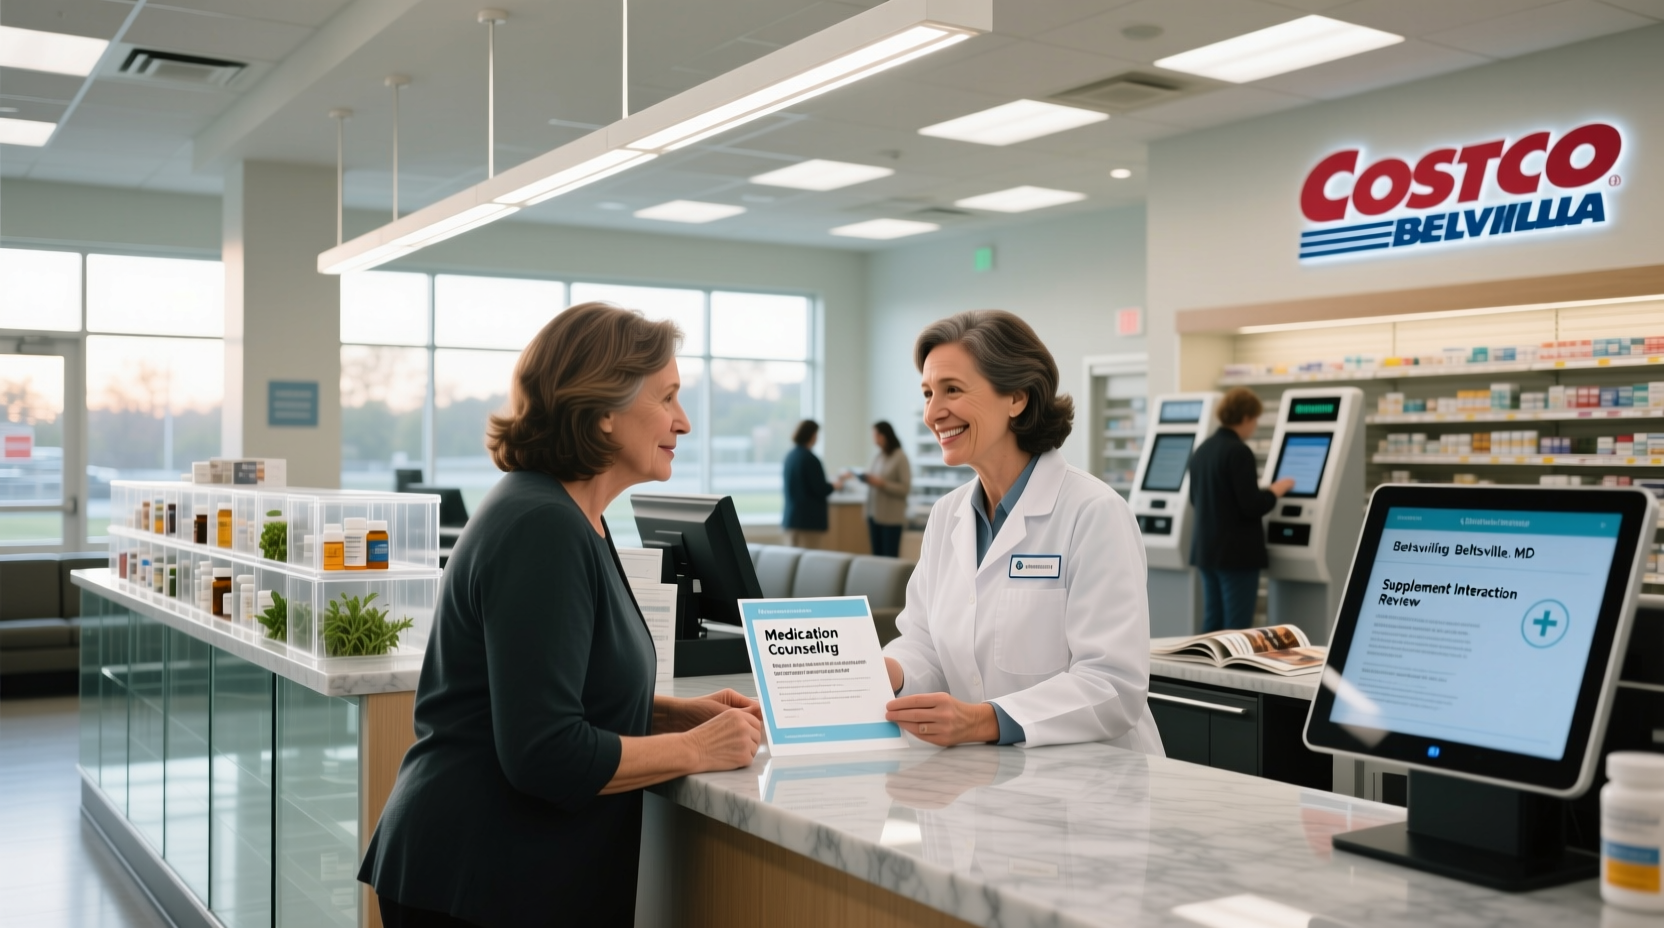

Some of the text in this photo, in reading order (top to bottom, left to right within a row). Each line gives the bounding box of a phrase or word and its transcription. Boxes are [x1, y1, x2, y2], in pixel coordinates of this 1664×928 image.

[1300, 123, 1623, 223] COSTCO
[1514, 546, 1535, 560] MD
[1382, 578, 1518, 600] Supplement Interaction
[1378, 593, 1421, 607] Review
[765, 626, 839, 641] Medication
